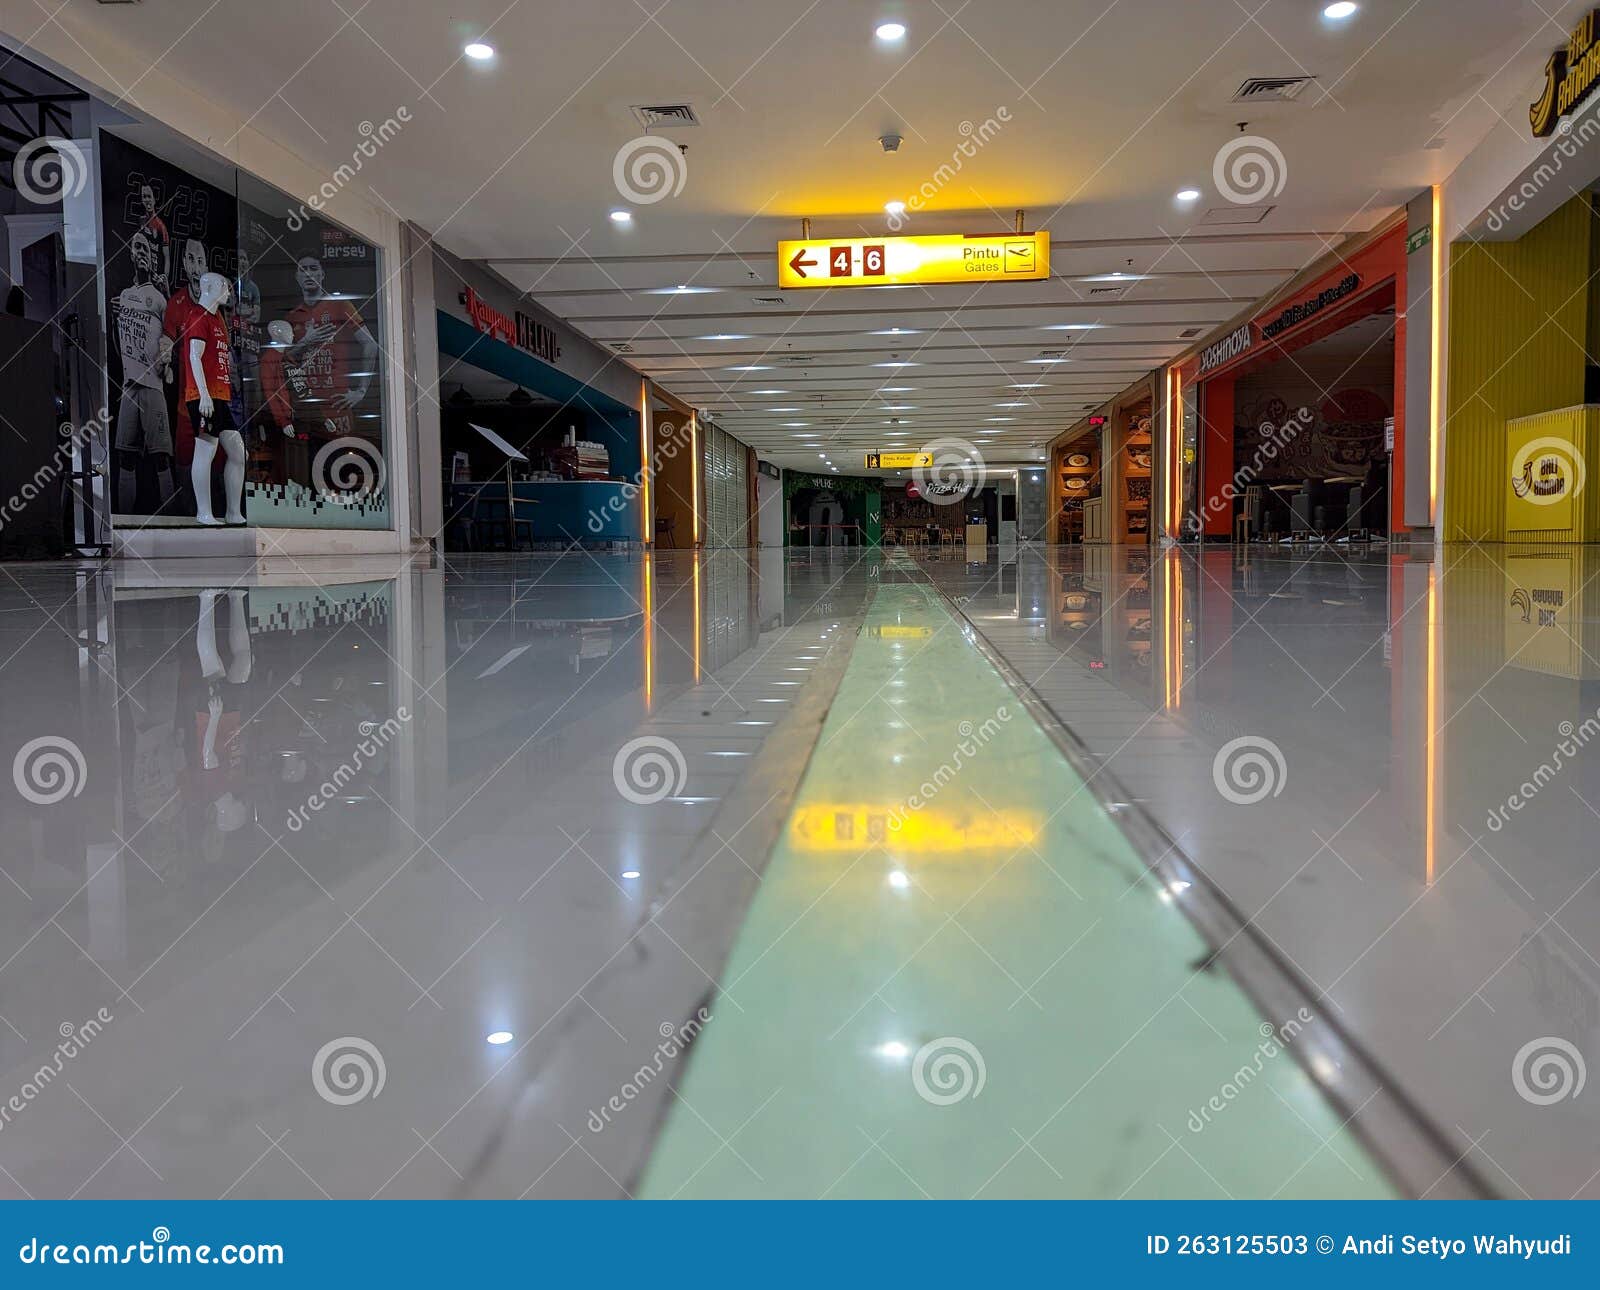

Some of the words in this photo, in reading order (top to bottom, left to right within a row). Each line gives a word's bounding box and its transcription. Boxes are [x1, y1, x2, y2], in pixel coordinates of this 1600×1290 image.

[1568, 9, 1595, 67] BALI
[322, 243, 366, 259] jersey
[963, 247, 1000, 260] Pintu
[964, 261, 1000, 273] Gates
[925, 482, 951, 495] Pizza
[951, 482, 970, 493] Hut
